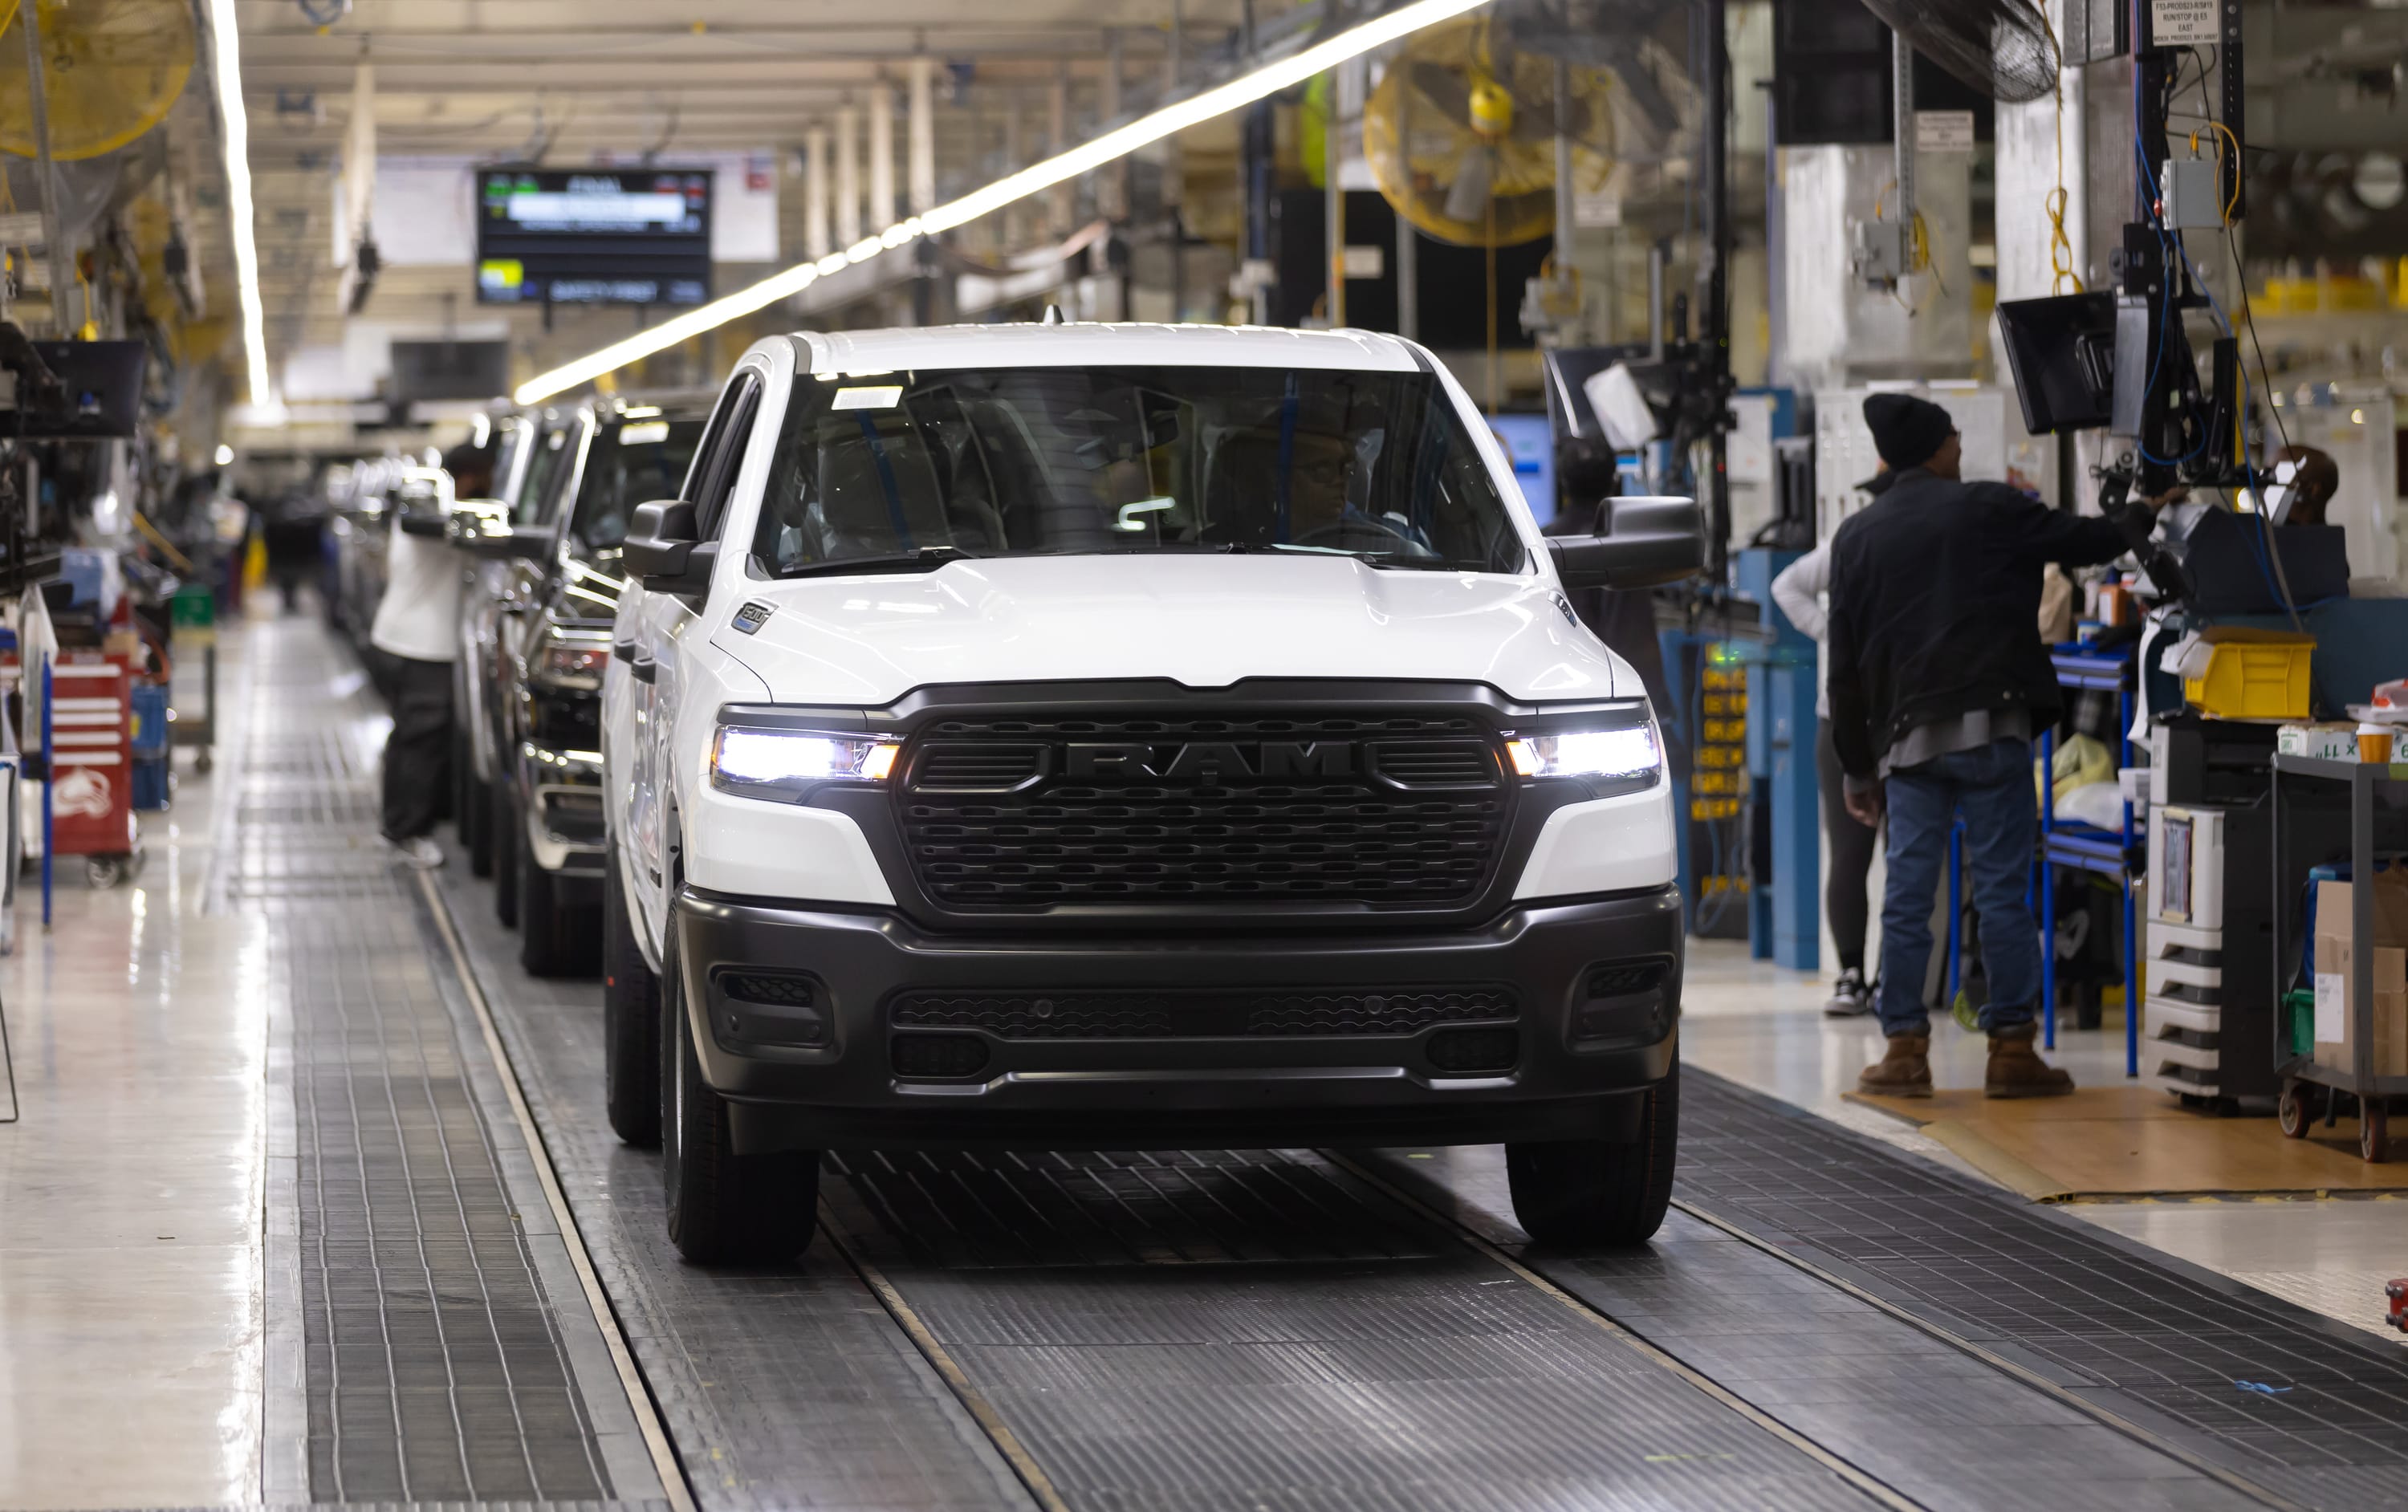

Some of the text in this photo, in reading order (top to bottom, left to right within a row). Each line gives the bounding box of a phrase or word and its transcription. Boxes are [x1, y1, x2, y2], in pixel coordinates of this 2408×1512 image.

[2162, 13, 2192, 21] RUN/STOP
[2178, 24, 2193, 32] EAST
[1066, 742, 1357, 777] RAM
